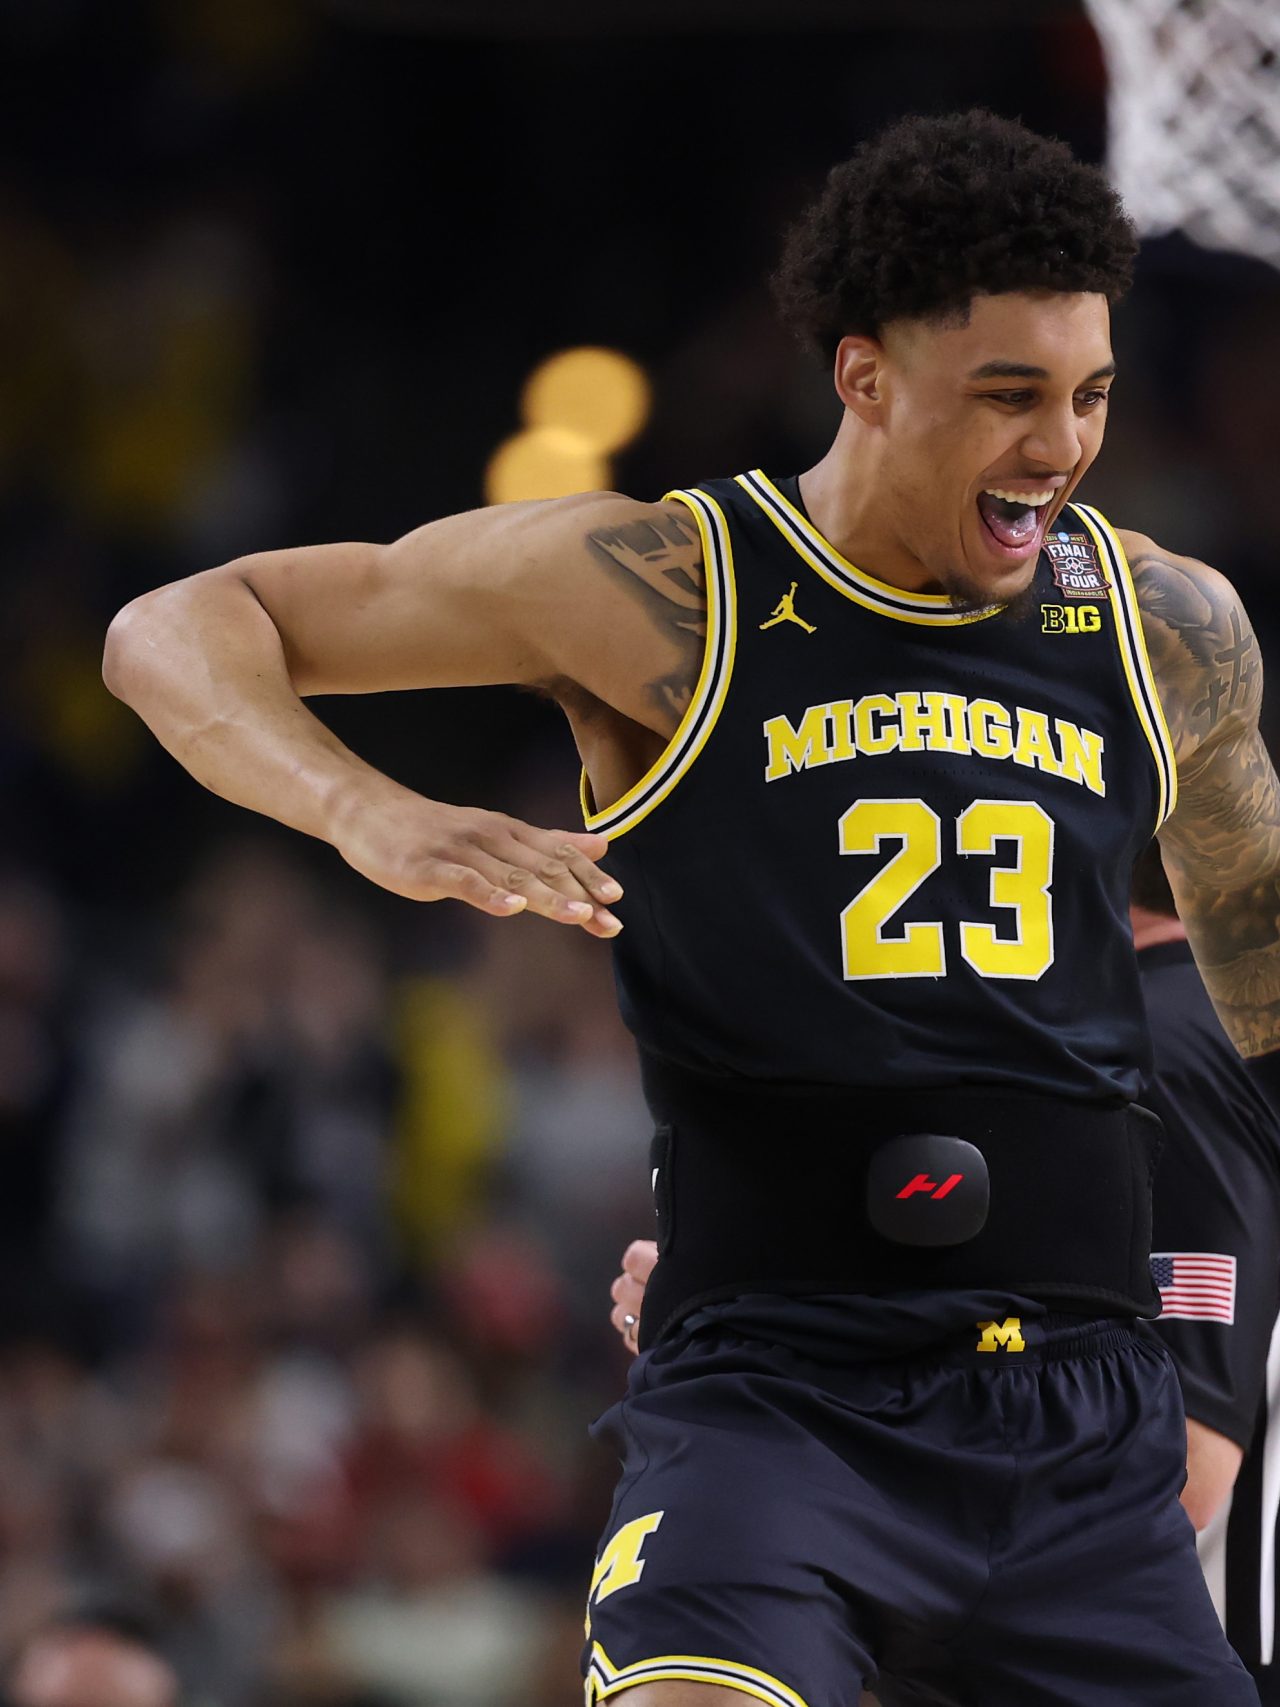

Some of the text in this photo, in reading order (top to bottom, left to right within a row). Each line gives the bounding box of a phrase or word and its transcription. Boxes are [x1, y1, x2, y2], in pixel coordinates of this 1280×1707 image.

[1047, 544, 1090, 559] FINAL
[1061, 573, 1101, 589] FOUR
[763, 691, 1106, 798] MICHIGAN
[838, 798, 1055, 981] 23
[976, 1317, 1026, 1352] M
